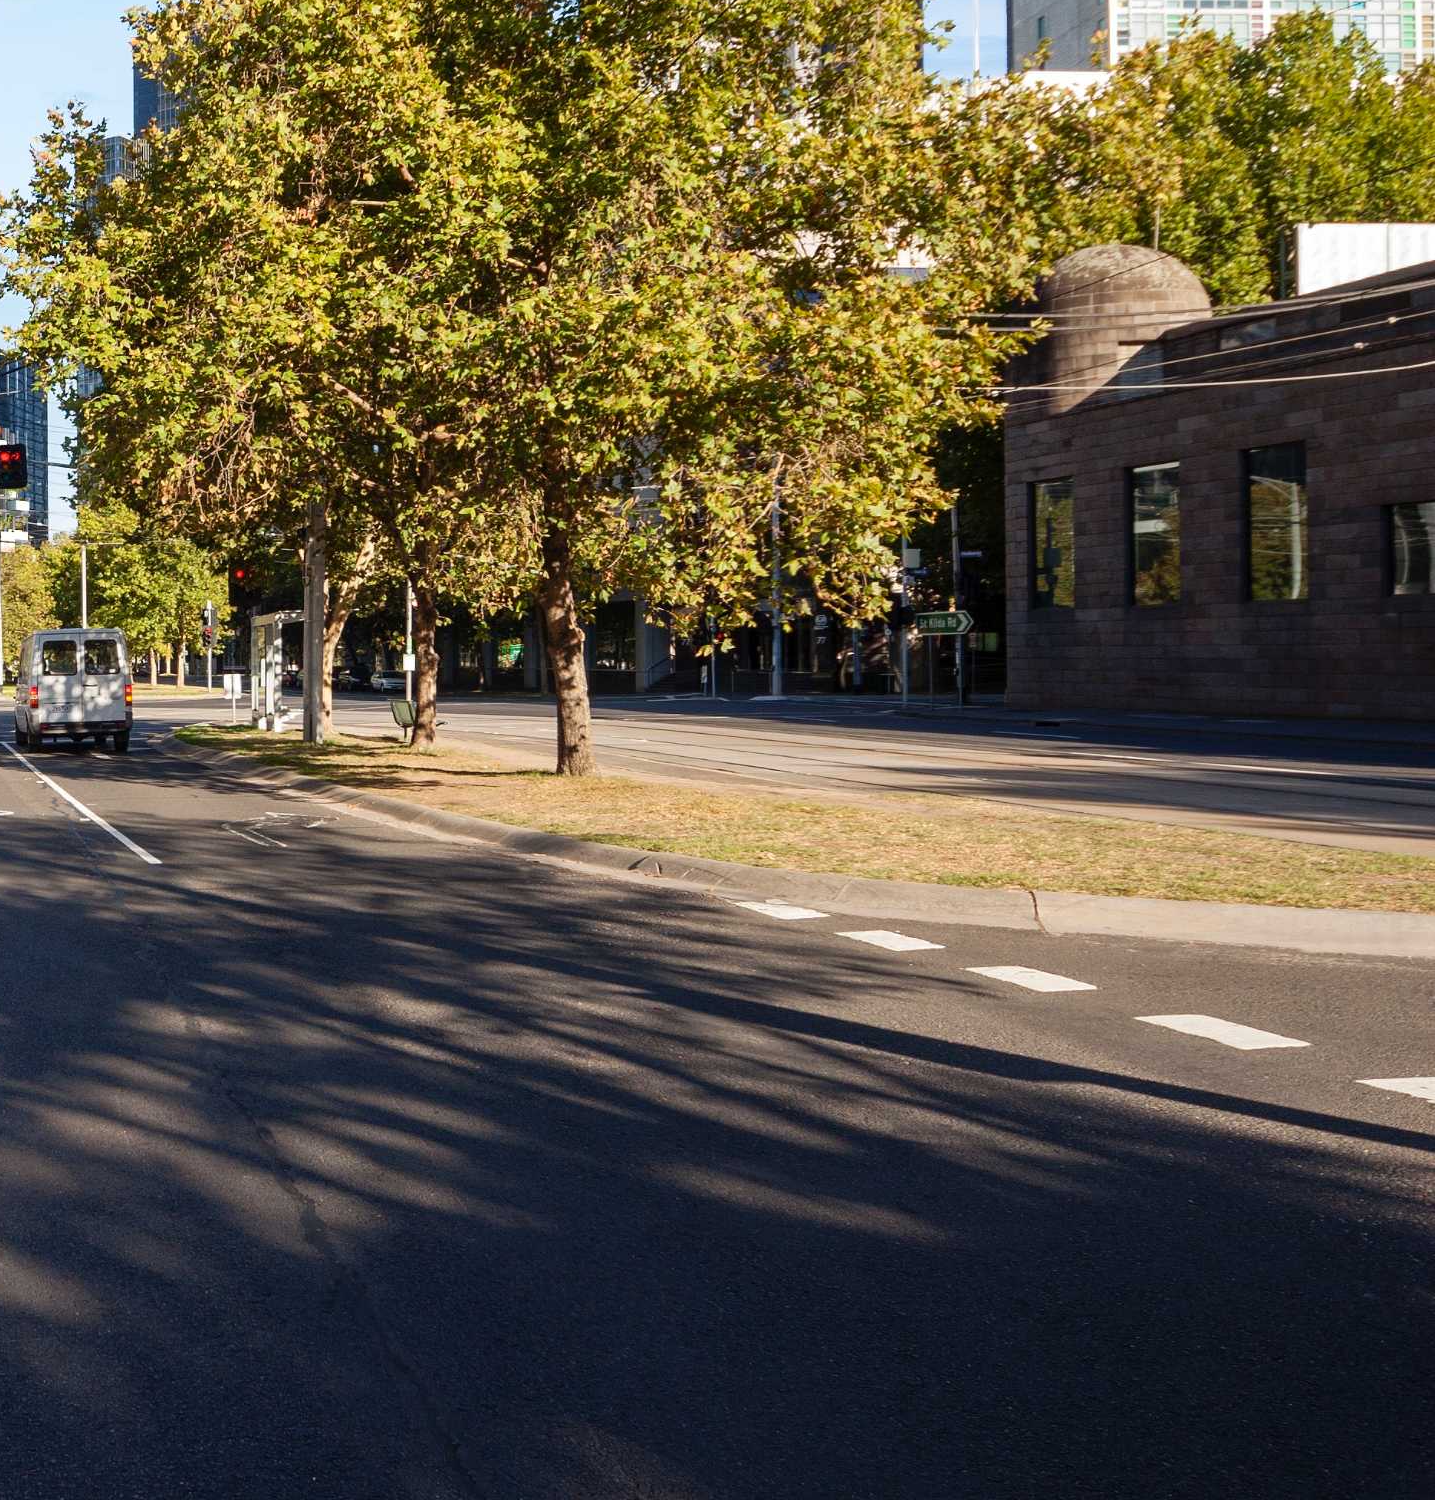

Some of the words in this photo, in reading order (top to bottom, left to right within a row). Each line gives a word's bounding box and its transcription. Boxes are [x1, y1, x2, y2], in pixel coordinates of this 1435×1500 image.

[919, 618, 928, 628] St
[929, 617, 946, 628] Kilda
[947, 616, 957, 628] Rd
